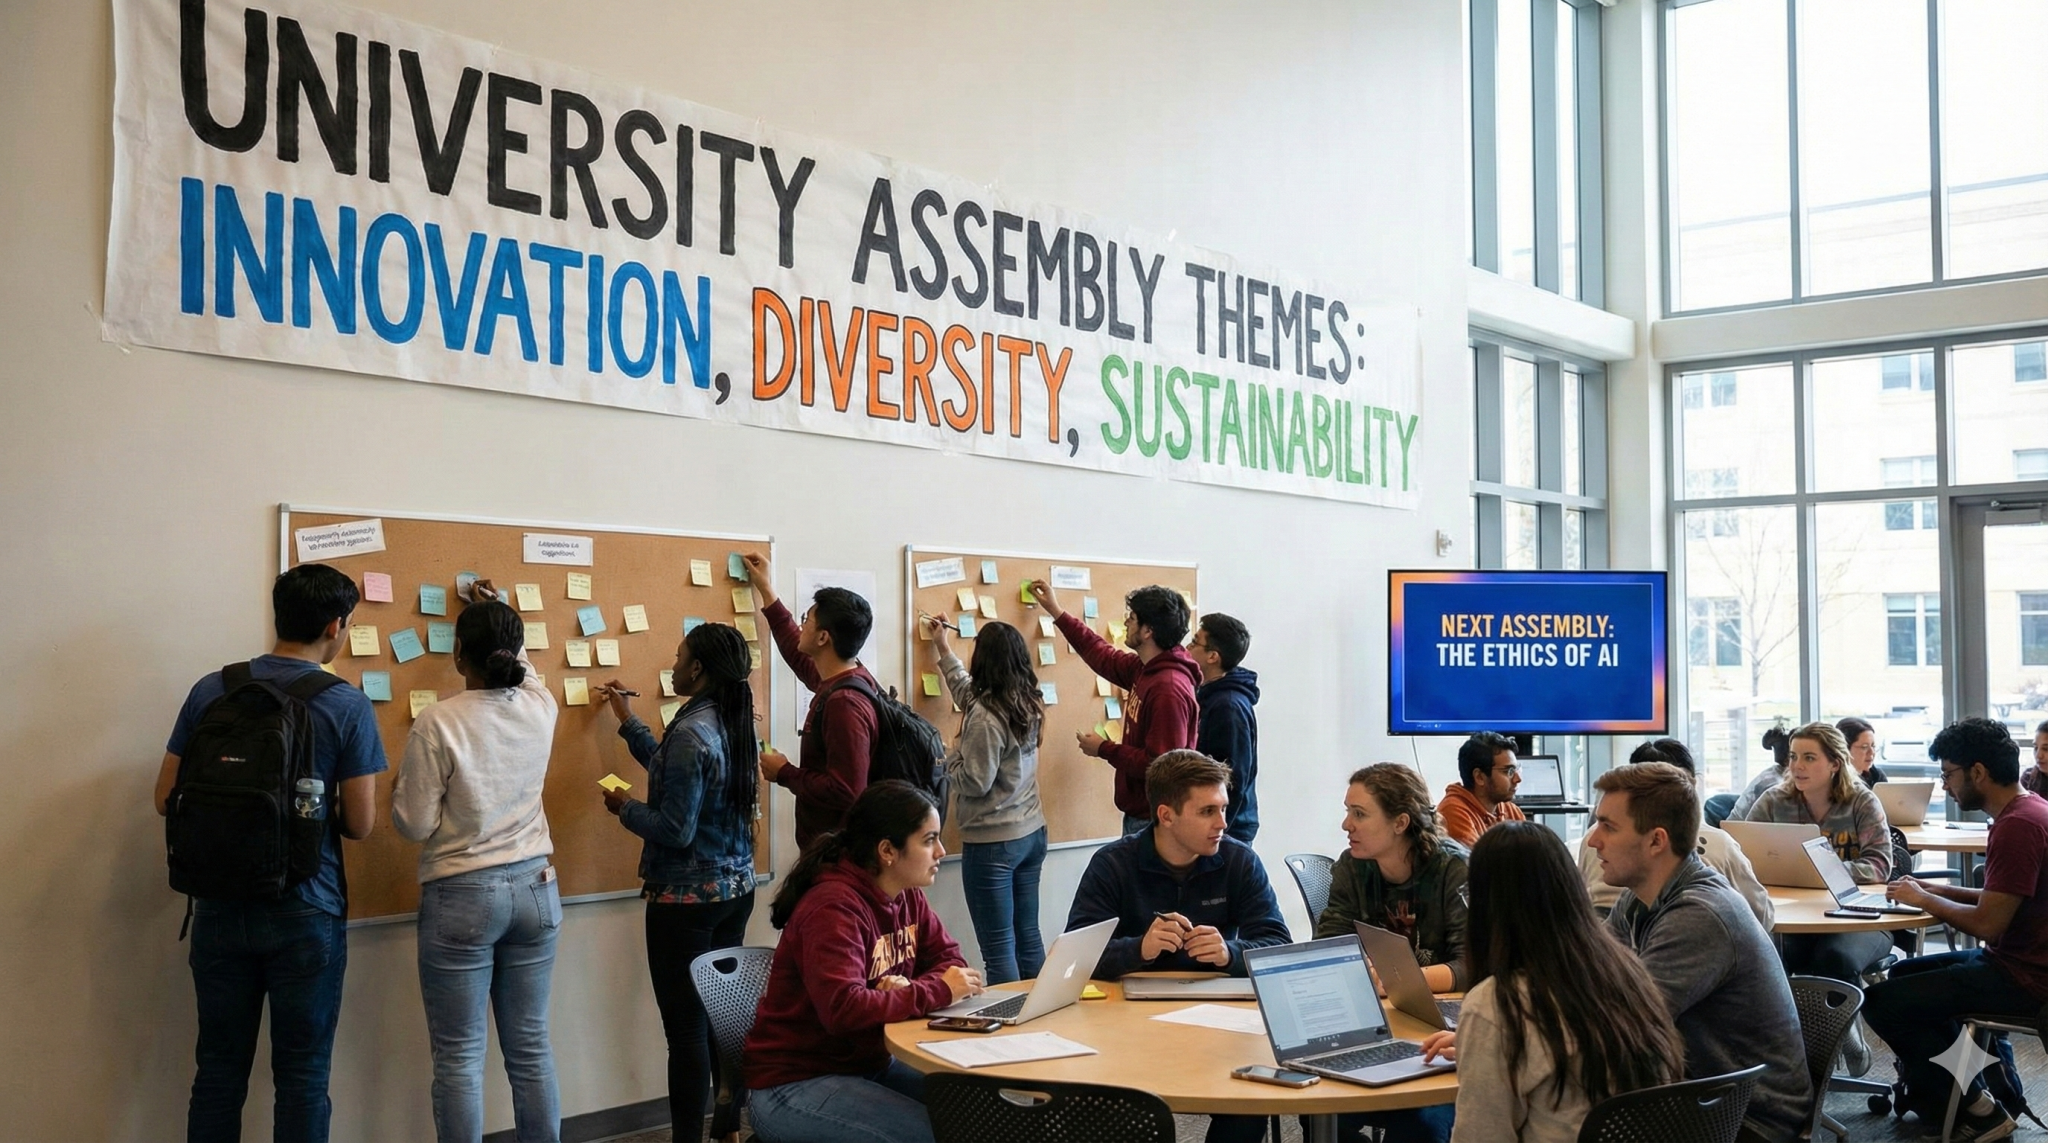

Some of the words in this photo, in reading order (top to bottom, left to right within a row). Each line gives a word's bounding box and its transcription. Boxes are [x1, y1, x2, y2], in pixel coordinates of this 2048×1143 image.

[179, 0, 816, 269] UNIVERSITY
[852, 177, 1165, 345] ASSEMBLY
[1185, 262, 1366, 385] THEMES:
[180, 177, 730, 405] INNOVATION,
[752, 287, 1080, 458] DIVERSITY,
[1100, 353, 1418, 493] SUSTAINABILITY
[1436, 643, 1475, 667] THE
[1483, 643, 1557, 667] ETHICS
[1564, 643, 1592, 667] OF
[1597, 643, 1619, 667] AI
[1441, 613, 1495, 638] NEXT
[1500, 614, 1614, 639] ASSEMBLY:
